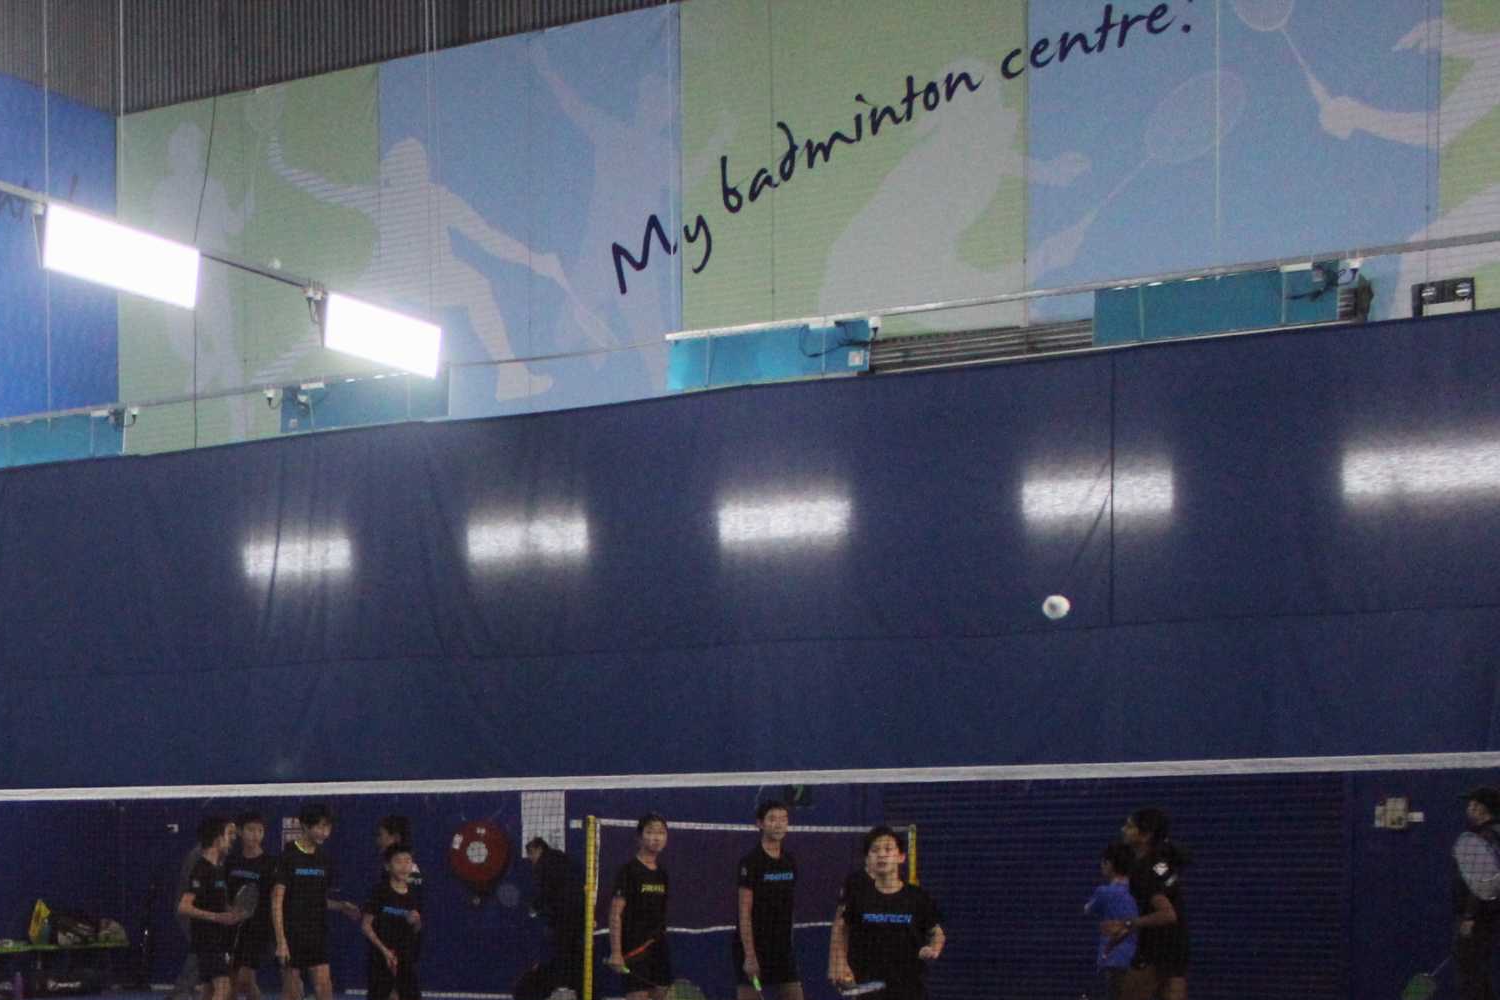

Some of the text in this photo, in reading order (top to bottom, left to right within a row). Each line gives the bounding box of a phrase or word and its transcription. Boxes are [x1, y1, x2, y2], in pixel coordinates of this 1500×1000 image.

[611, 0, 1191, 294] My badminton centre
